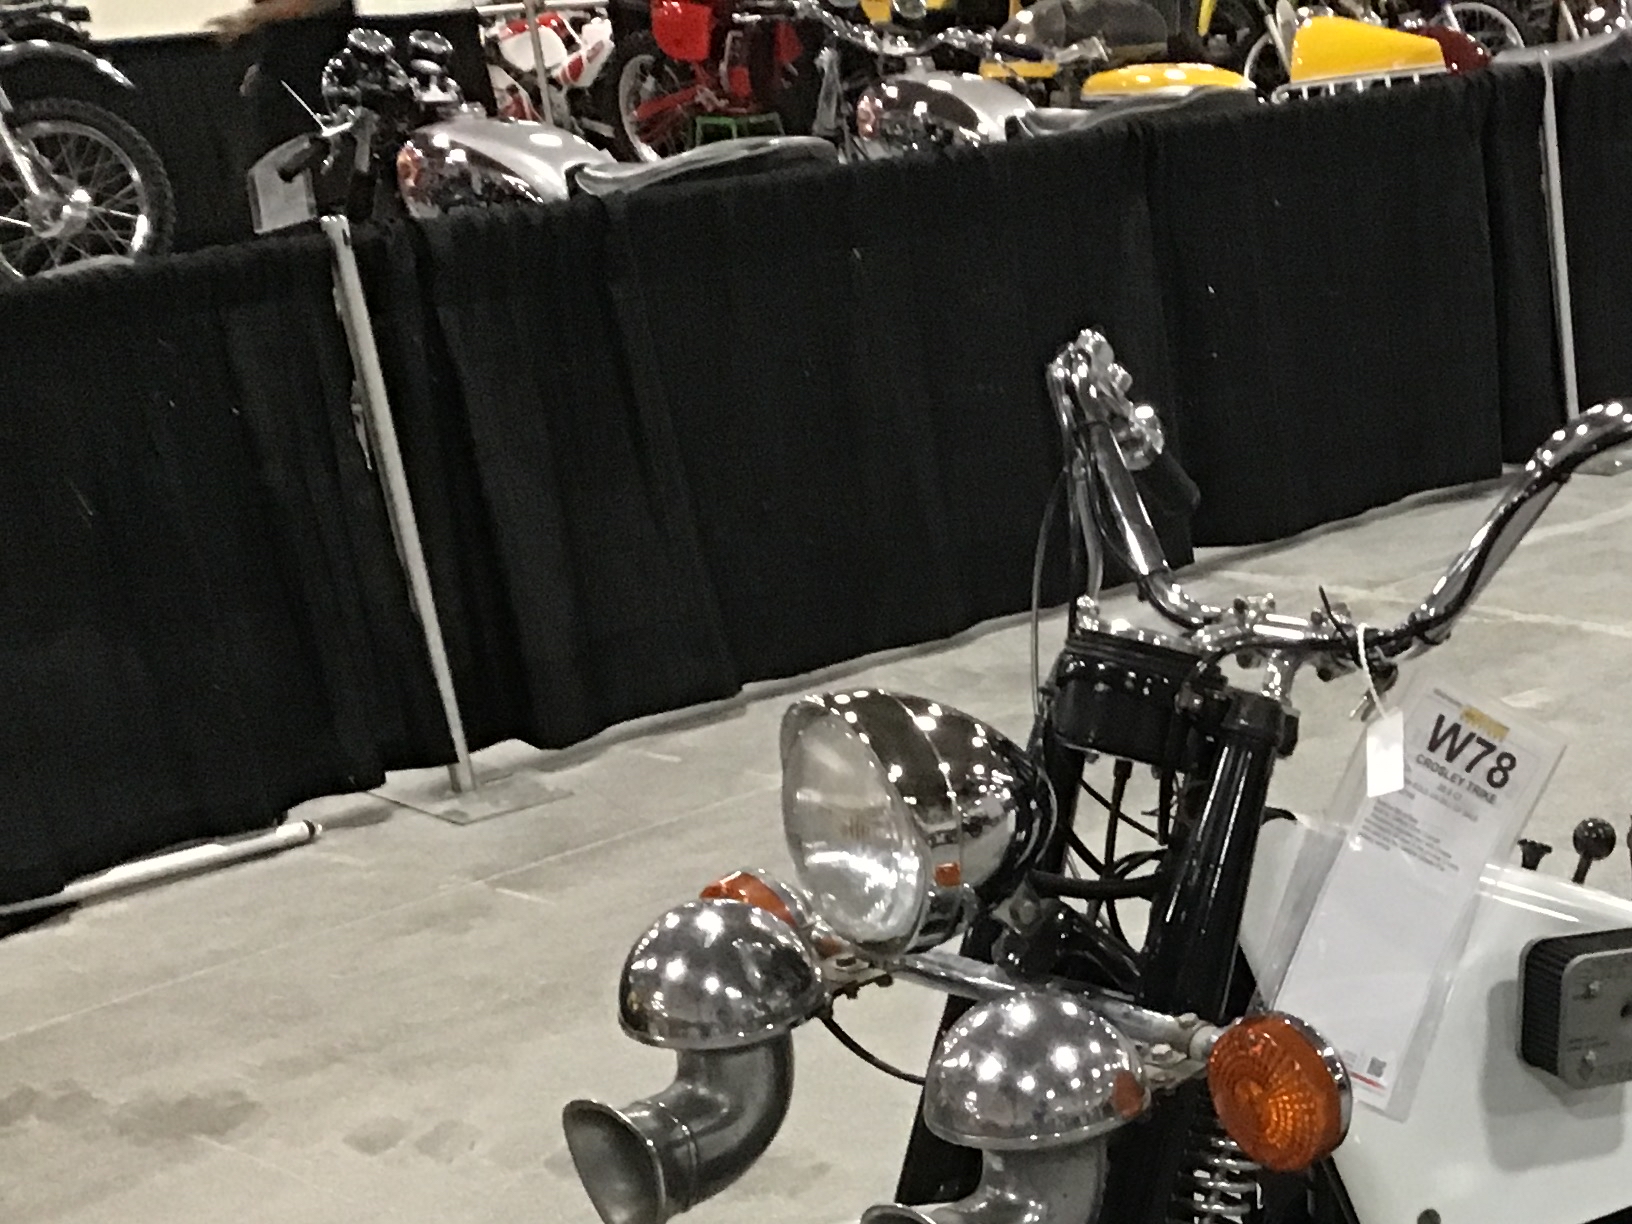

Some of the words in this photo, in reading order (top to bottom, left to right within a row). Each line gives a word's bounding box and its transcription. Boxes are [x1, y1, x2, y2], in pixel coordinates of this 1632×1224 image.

[1416, 754, 1466, 786] CROSLEY
[1466, 781, 1498, 806] TRIKE
[1427, 713, 1517, 789] W78
